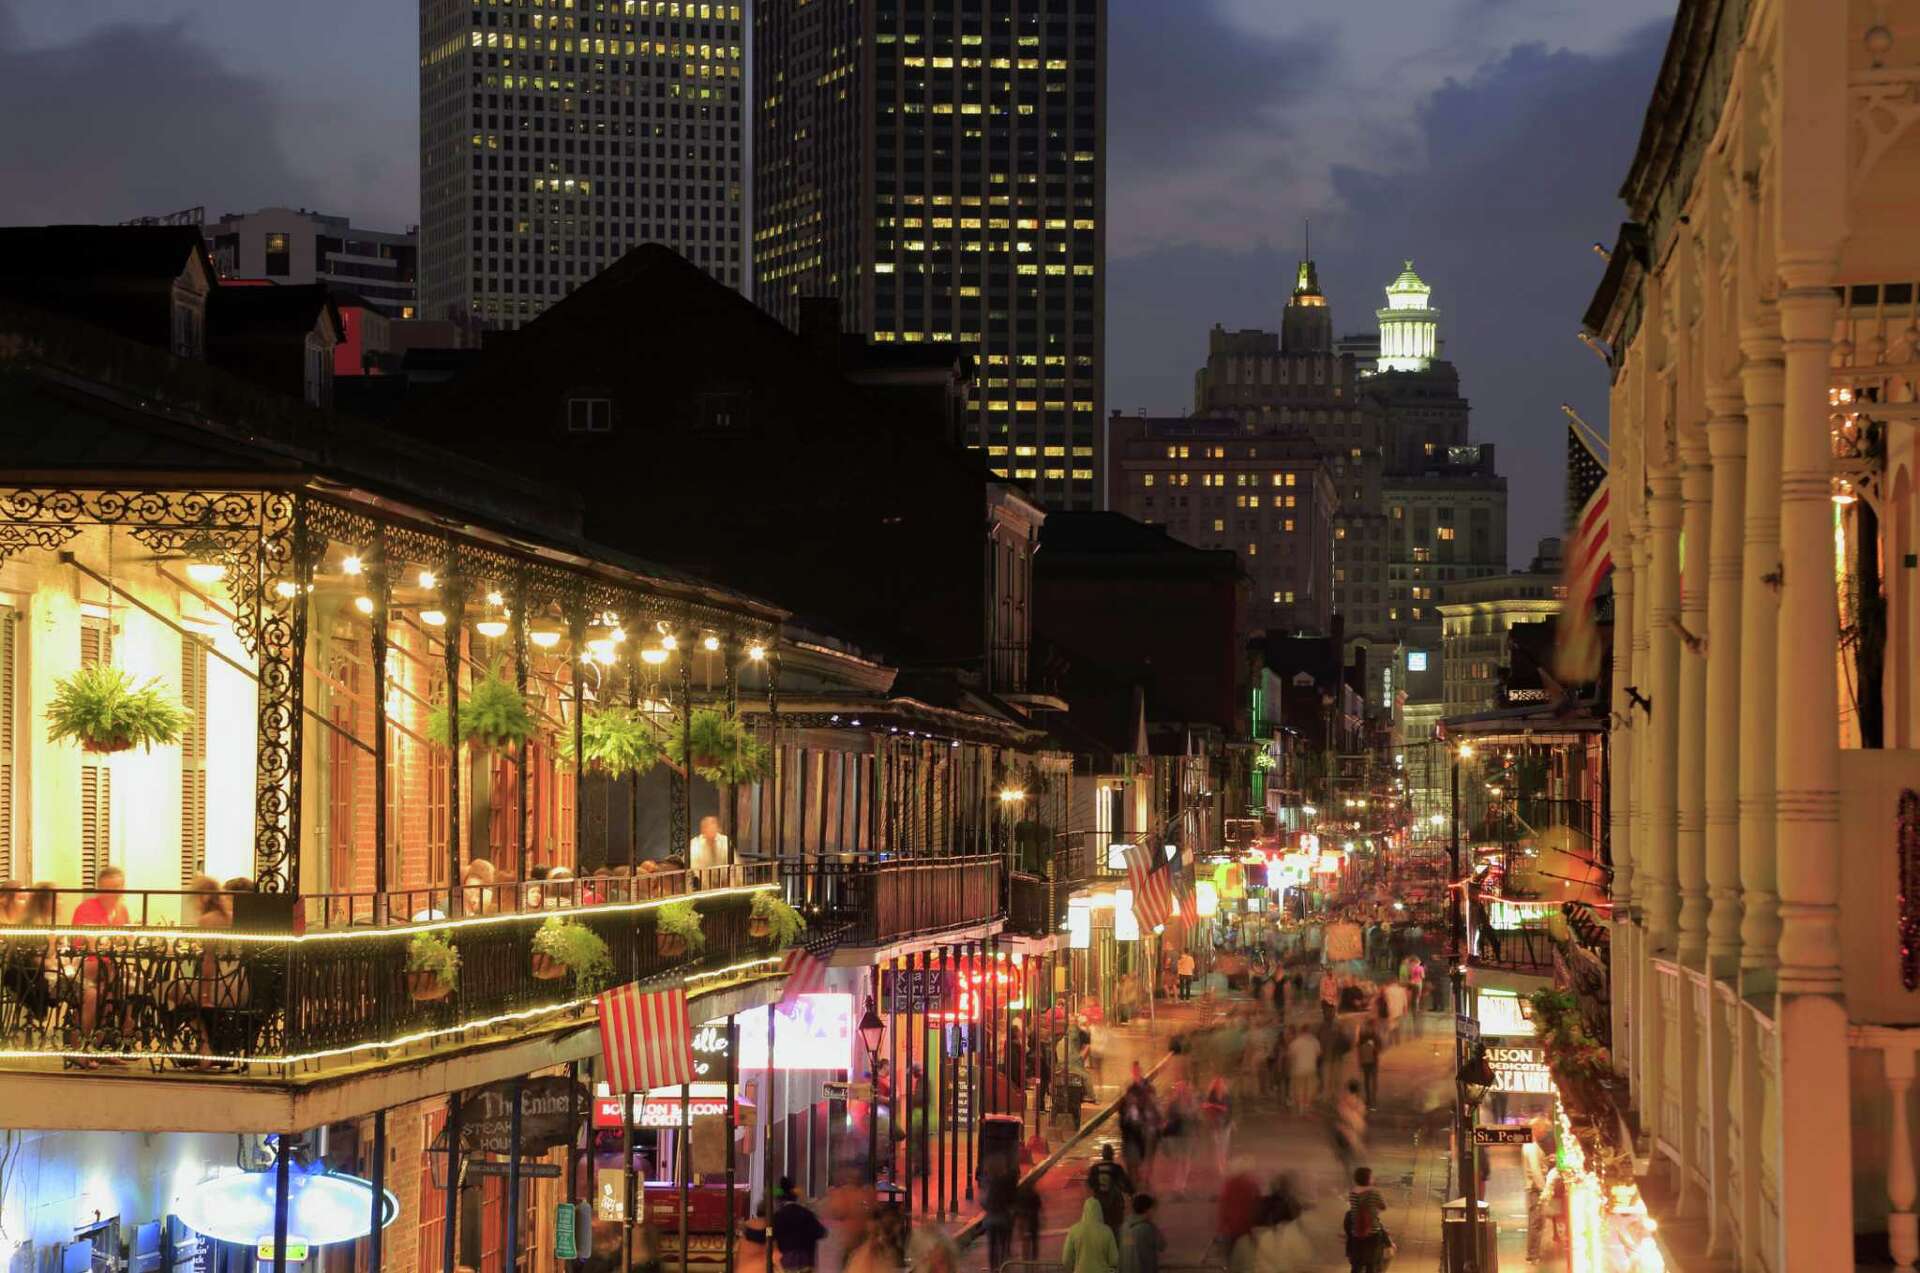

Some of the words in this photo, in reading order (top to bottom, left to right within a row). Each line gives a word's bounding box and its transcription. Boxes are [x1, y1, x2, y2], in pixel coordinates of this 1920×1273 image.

[1484, 1049, 1533, 1062] AISON
[478, 1090, 514, 1119] Th
[602, 1103, 668, 1115] BOON
[1498, 1131, 1531, 1142] Per
